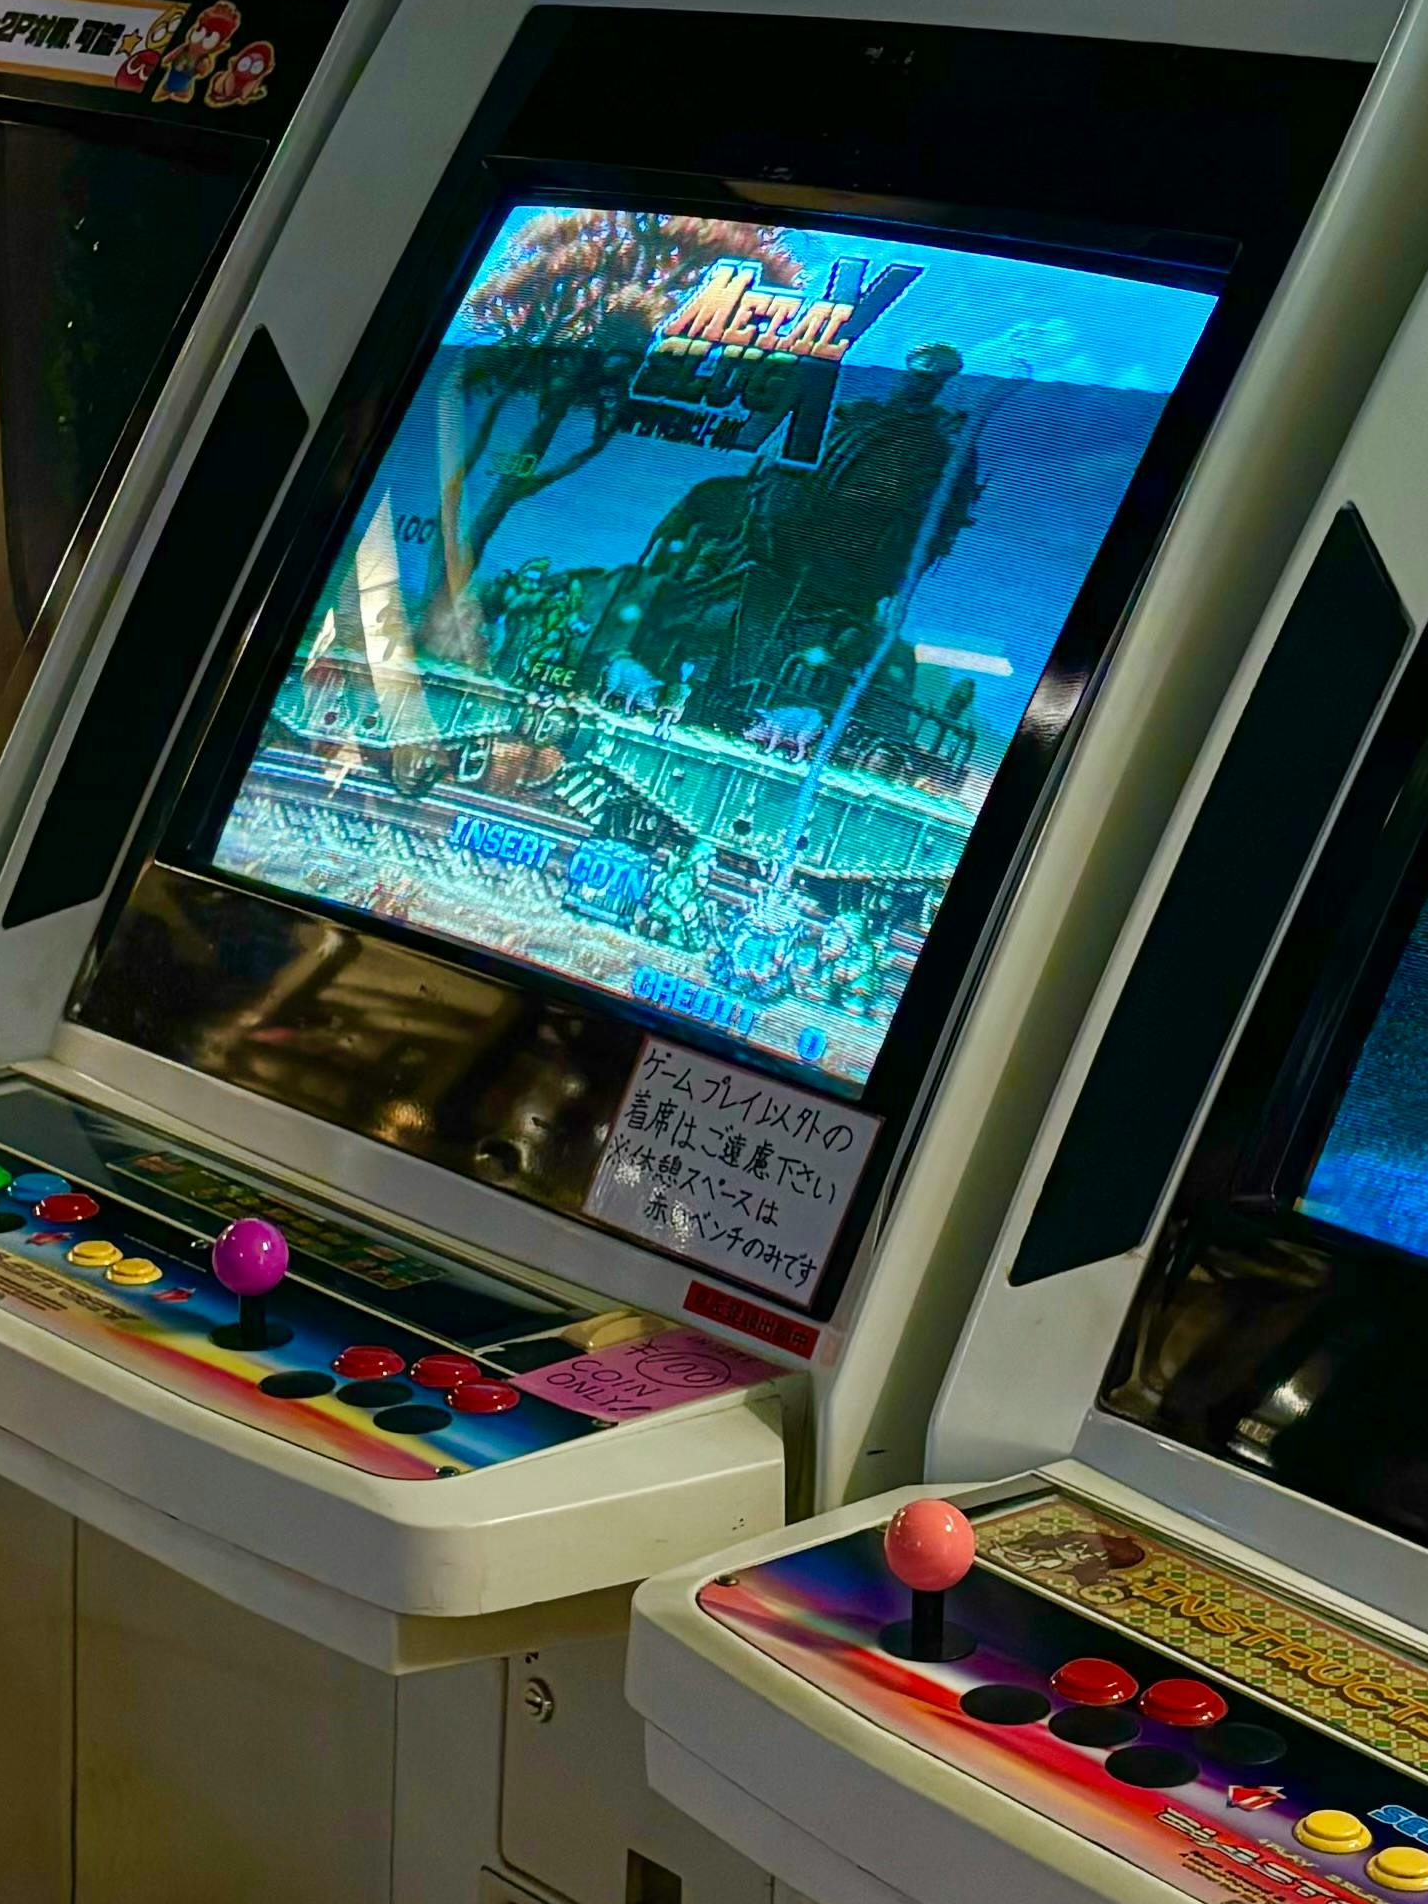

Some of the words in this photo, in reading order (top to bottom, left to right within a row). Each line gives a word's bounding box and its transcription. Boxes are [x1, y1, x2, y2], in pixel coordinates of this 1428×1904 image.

[664, 265, 855, 361] METAL
[530, 662, 576, 688] FIRE
[448, 814, 556, 870] INSERT
[569, 851, 650, 898] COIN
[632, 964, 761, 1036] CREDIT
[624, 1089, 836, 1205] 着席はご遠慮下さい
[546, 1372, 652, 1413] ONLY!
[572, 1359, 664, 1397] COIN
